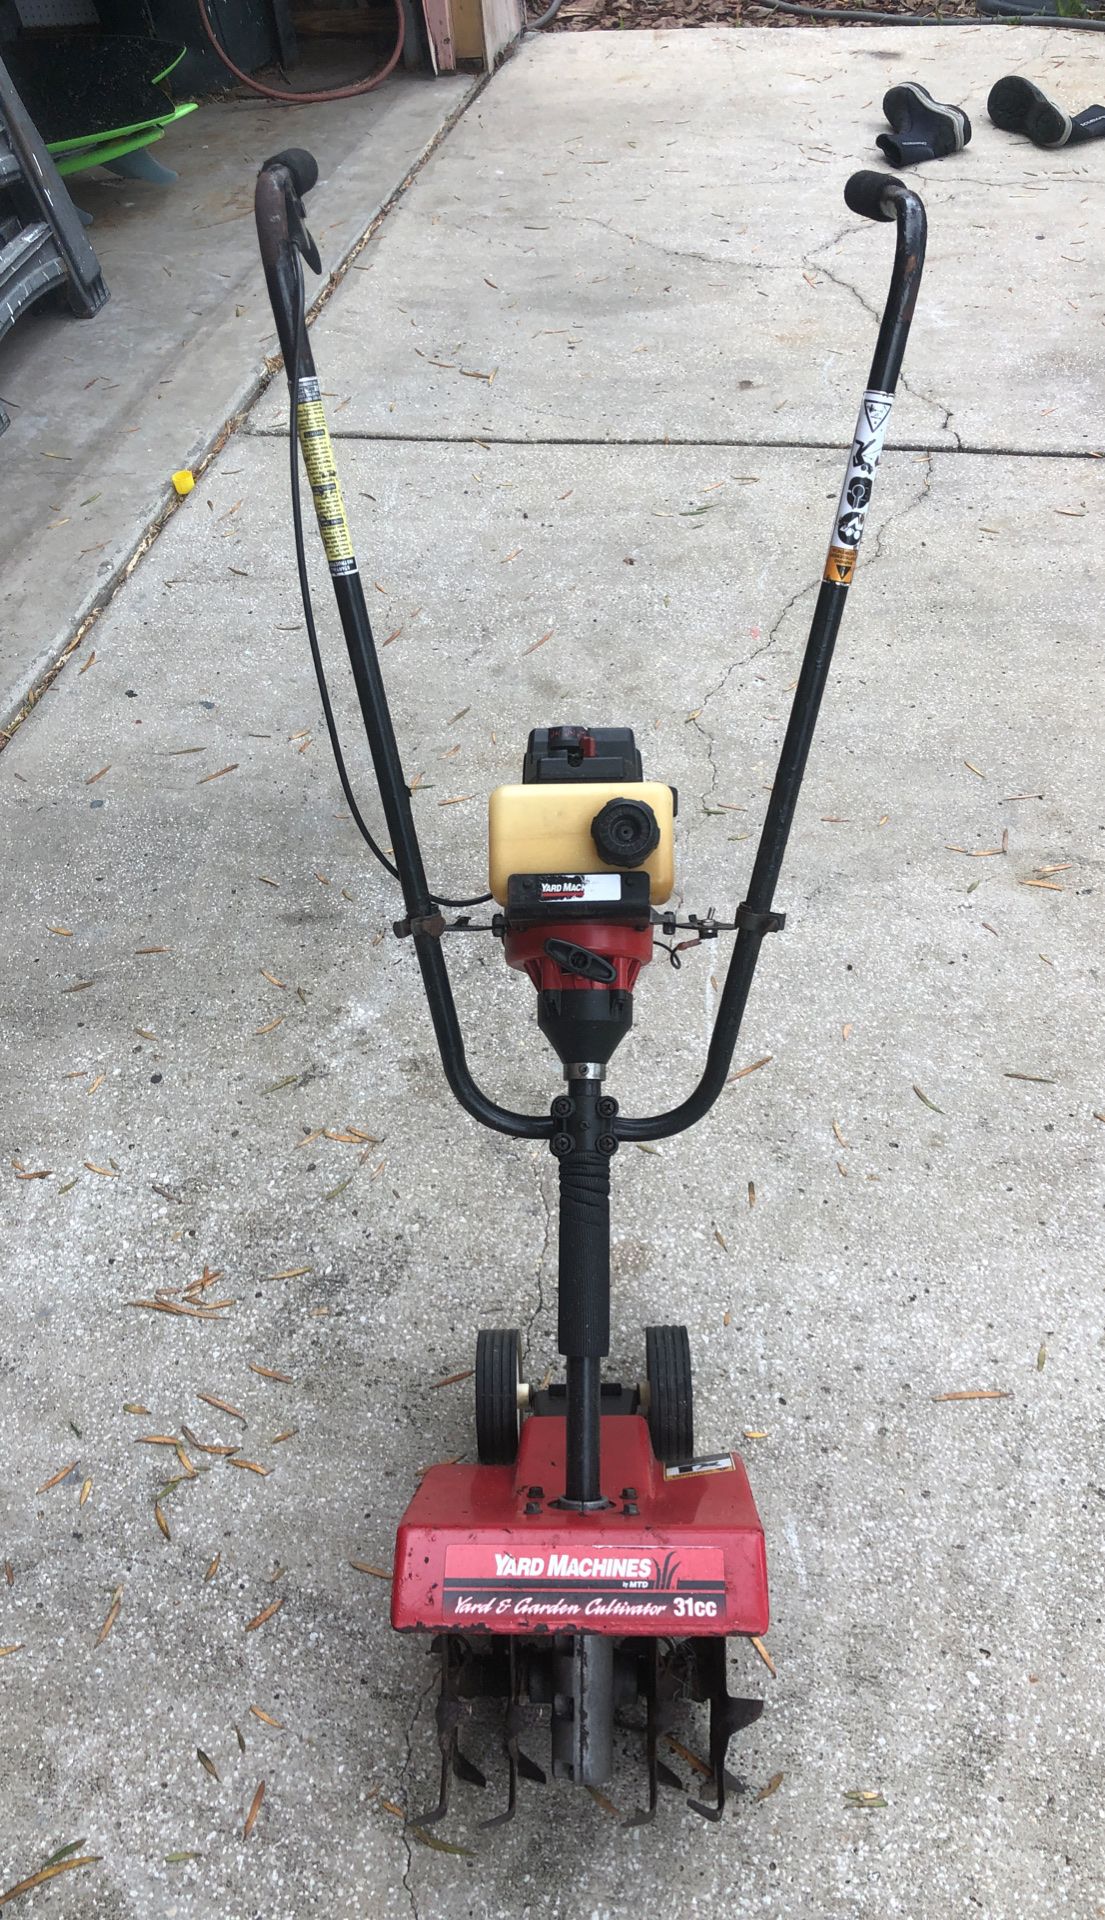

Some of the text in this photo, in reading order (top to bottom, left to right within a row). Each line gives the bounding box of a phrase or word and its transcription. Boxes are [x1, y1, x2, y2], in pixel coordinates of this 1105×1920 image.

[541, 883, 562, 892] YARD
[494, 1553, 652, 1578] YARD MACHINES
[622, 1581, 649, 1589] by MTD
[454, 1596, 717, 1617] Yard & Garden Cultivator 31cc
